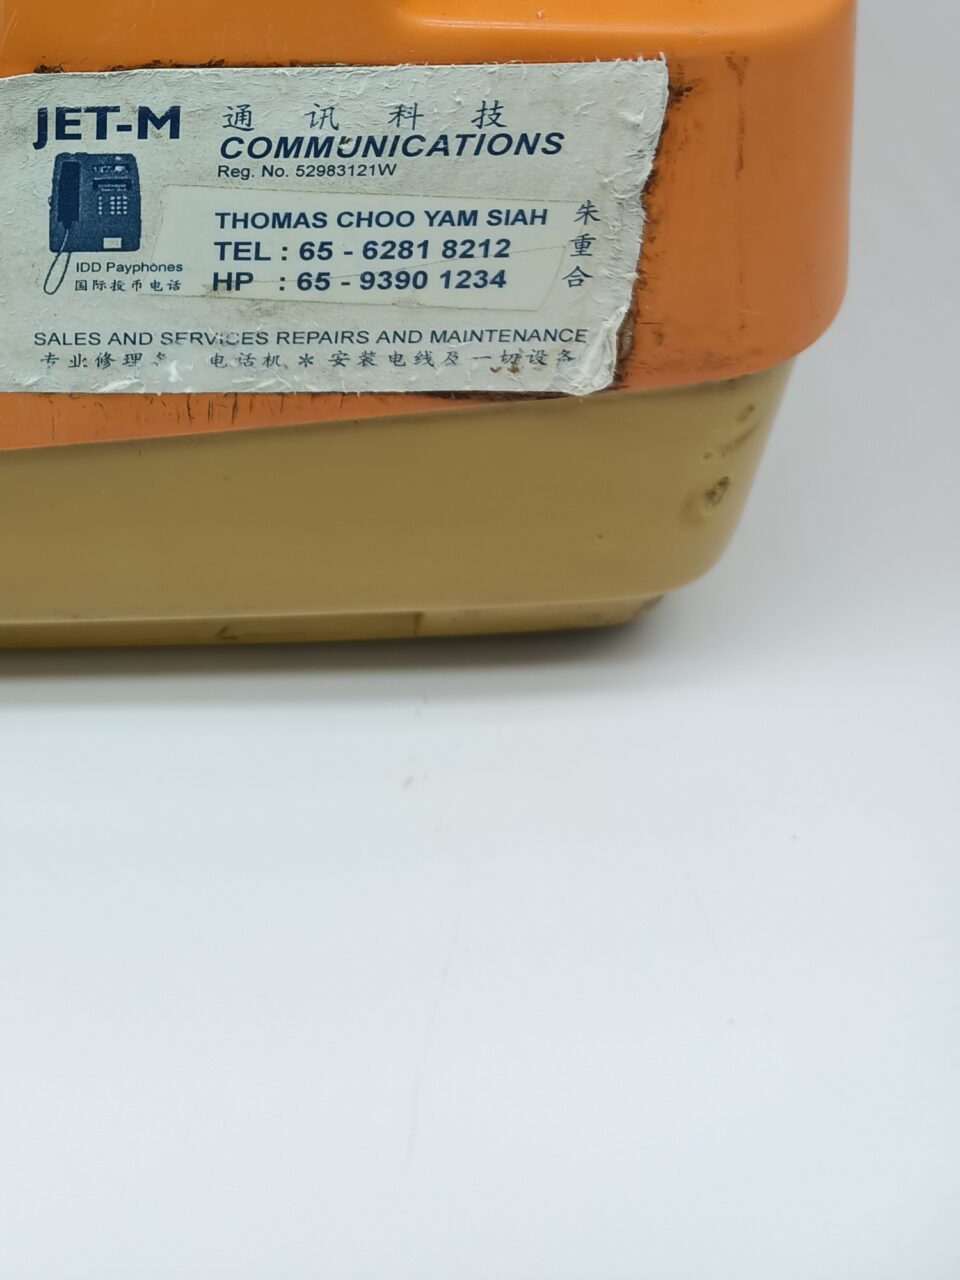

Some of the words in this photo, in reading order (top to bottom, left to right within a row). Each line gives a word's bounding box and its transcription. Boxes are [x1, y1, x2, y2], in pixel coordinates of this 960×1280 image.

[221, 99, 508, 132] 通讯科技
[32, 105, 182, 150] JET-M
[219, 131, 565, 160] COMMUNICATIONS
[217, 164, 255, 180] Reg.
[261, 164, 289, 178] No.
[294, 163, 398, 178] 52983121W
[214, 211, 328, 230] THOMAS
[336, 210, 415, 229] CHOO
[424, 209, 479, 228] YAM
[486, 208, 548, 227] SIAH
[213, 241, 272, 262] TEL
[298, 240, 333, 261] 65
[362, 239, 430, 261] 6281
[441, 238, 511, 260] 8212
[561, 199, 601, 289] 朱重合
[75, 261, 102, 273] IDD
[105, 260, 184, 276] Payphones
[74, 278, 182, 293] 国际投币电话
[212, 271, 254, 292] HP
[296, 271, 331, 292] 65
[359, 270, 428, 291] 9390
[439, 269, 507, 290] 1234
[33, 331, 102, 347] SALES
[107, 331, 154, 346] AND
[159, 330, 270, 347] SERVICES
[275, 329, 370, 346] REPAIRS
[376, 329, 423, 345] AND
[429, 327, 588, 345] MAINTENANCE
